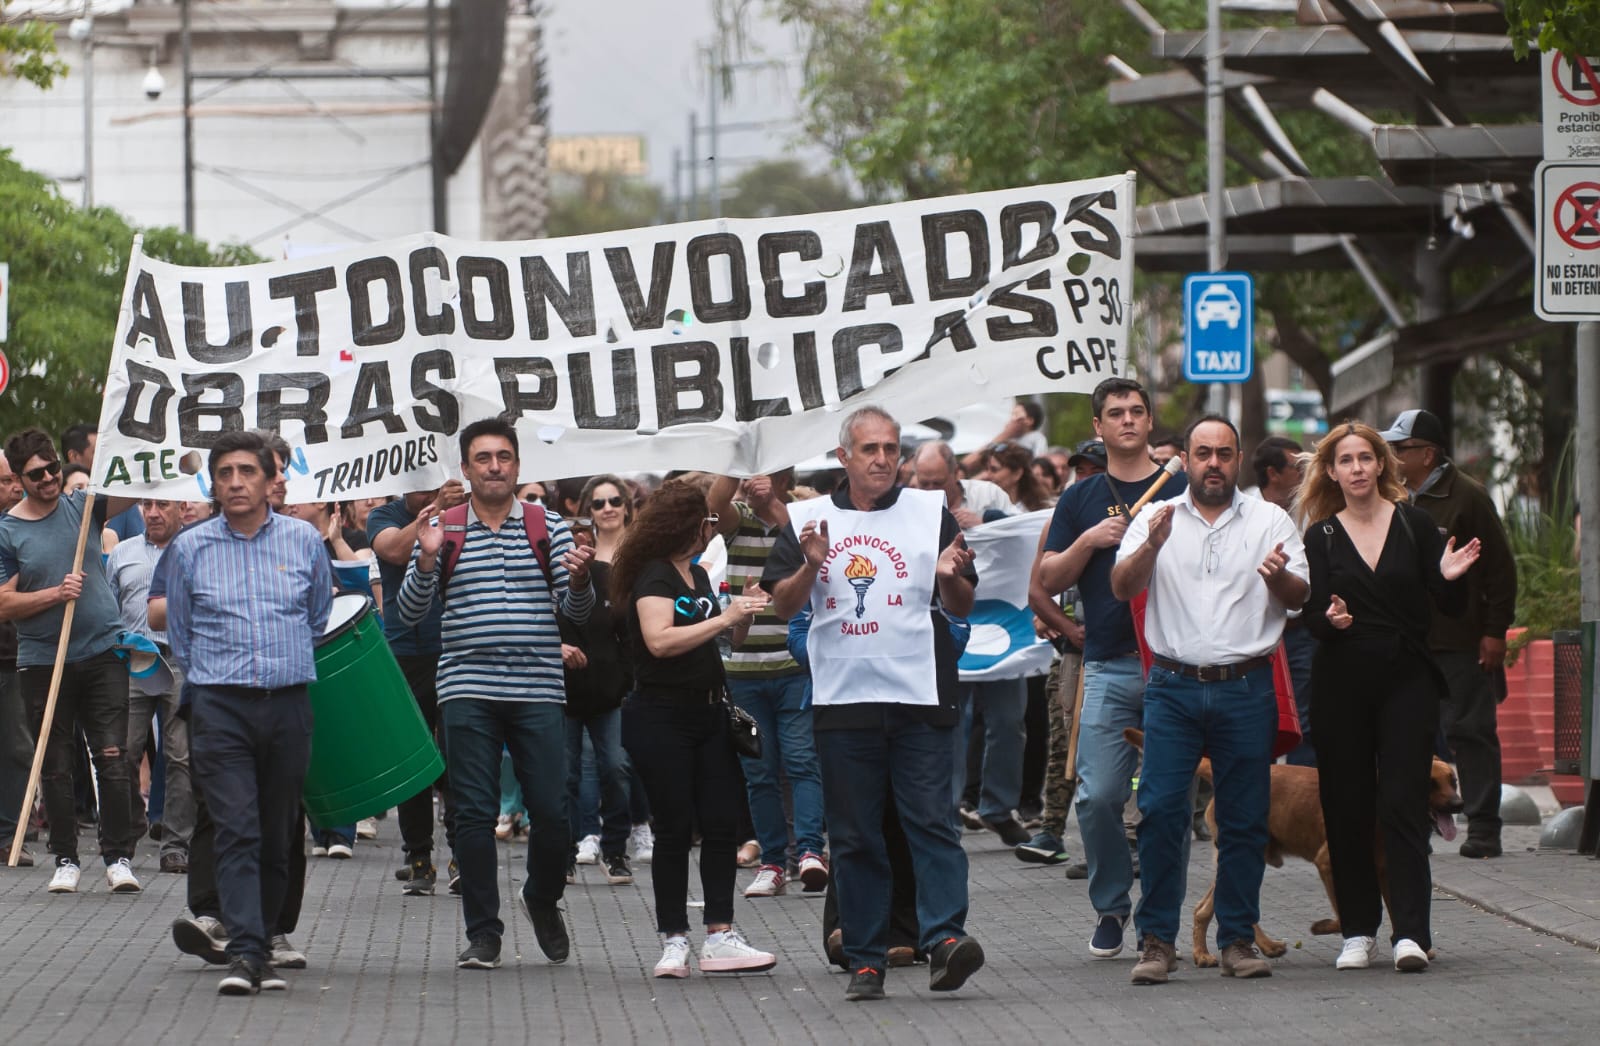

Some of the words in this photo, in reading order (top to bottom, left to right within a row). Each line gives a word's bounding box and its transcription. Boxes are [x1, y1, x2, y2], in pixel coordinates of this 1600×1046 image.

[1560, 111, 1600, 123] Prohib
[125, 190, 1121, 364] AUTOCONVOCADOS
[1547, 264, 1561, 278] NO
[1564, 264, 1600, 278] ESTACI
[1552, 281, 1562, 295] NI
[1063, 276, 1122, 326] P30
[1036, 337, 1118, 380] CAPE
[1196, 350, 1242, 372] TAXI
[118, 349, 460, 449] OBRAS
[103, 448, 179, 488] ATE
[314, 433, 438, 499] TRAIDORES
[820, 535, 908, 584] AUTOCONVOCADOS
[826, 597, 837, 610] DE
[887, 594, 903, 606] LA
[841, 621, 879, 635] SALUD
